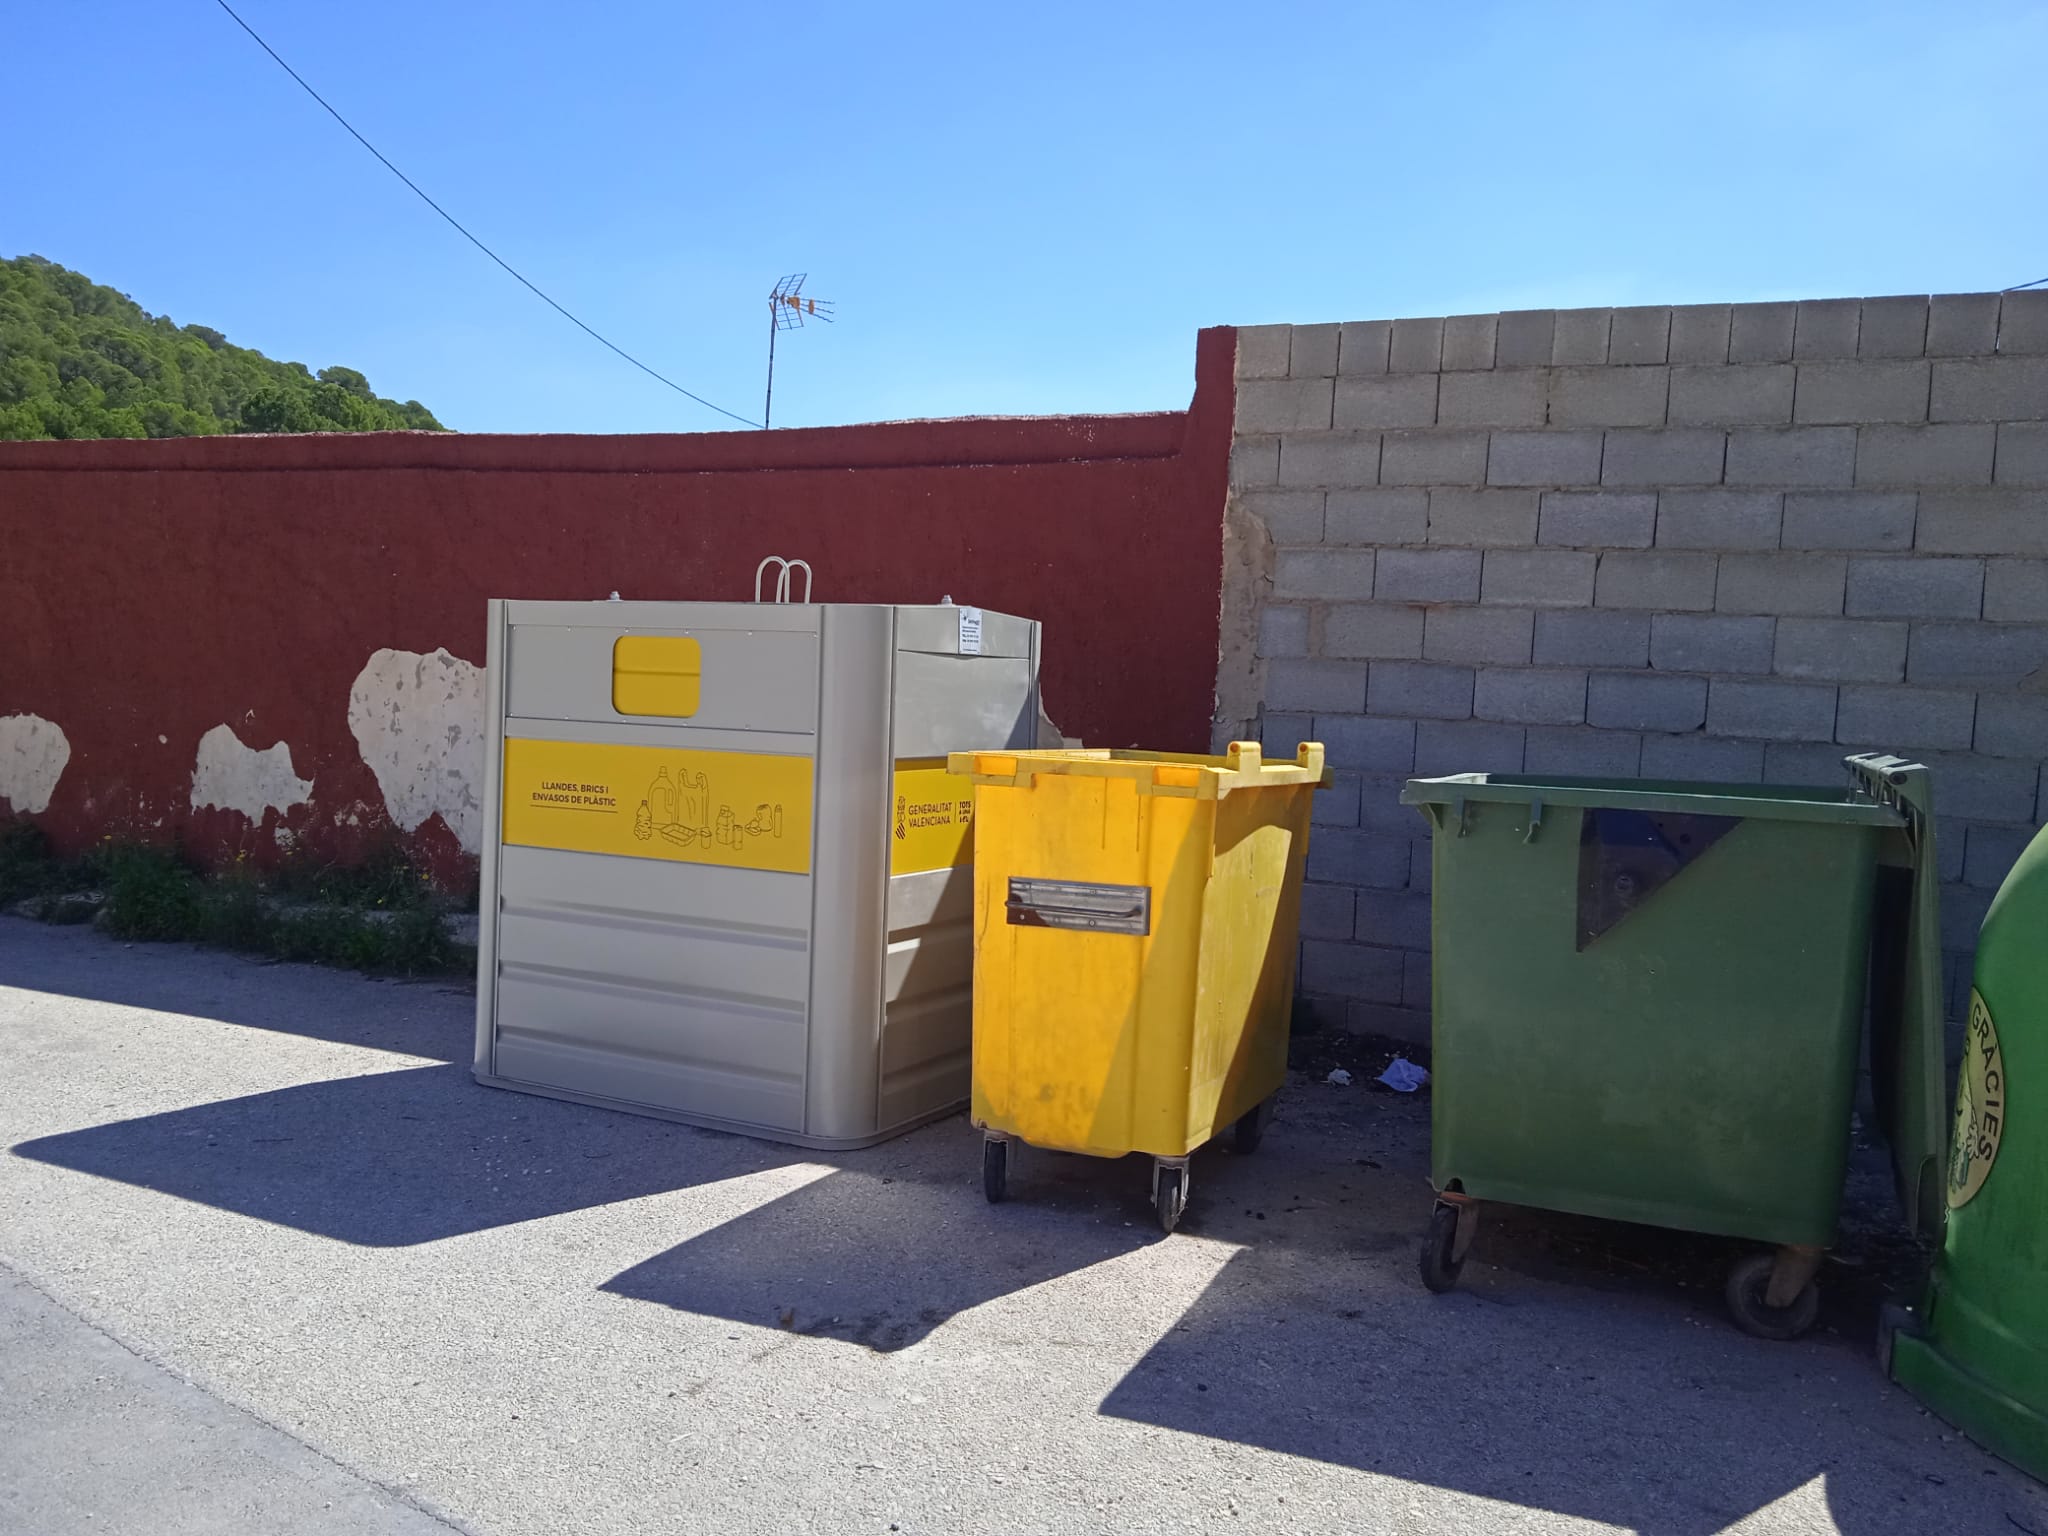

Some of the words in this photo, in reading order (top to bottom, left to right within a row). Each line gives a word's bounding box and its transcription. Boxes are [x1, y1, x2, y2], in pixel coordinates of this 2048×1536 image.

[541, 781, 579, 792] LLANDES,
[580, 784, 604, 794] BRICS
[532, 792, 569, 803] ENVASOS
[571, 795, 582, 804] DE
[583, 795, 616, 807] PLÀSTIC
[908, 802, 952, 815] GENERALITAT
[908, 816, 951, 828] VALENCIANA
[1971, 1003, 2000, 1161] GRÀCIES
